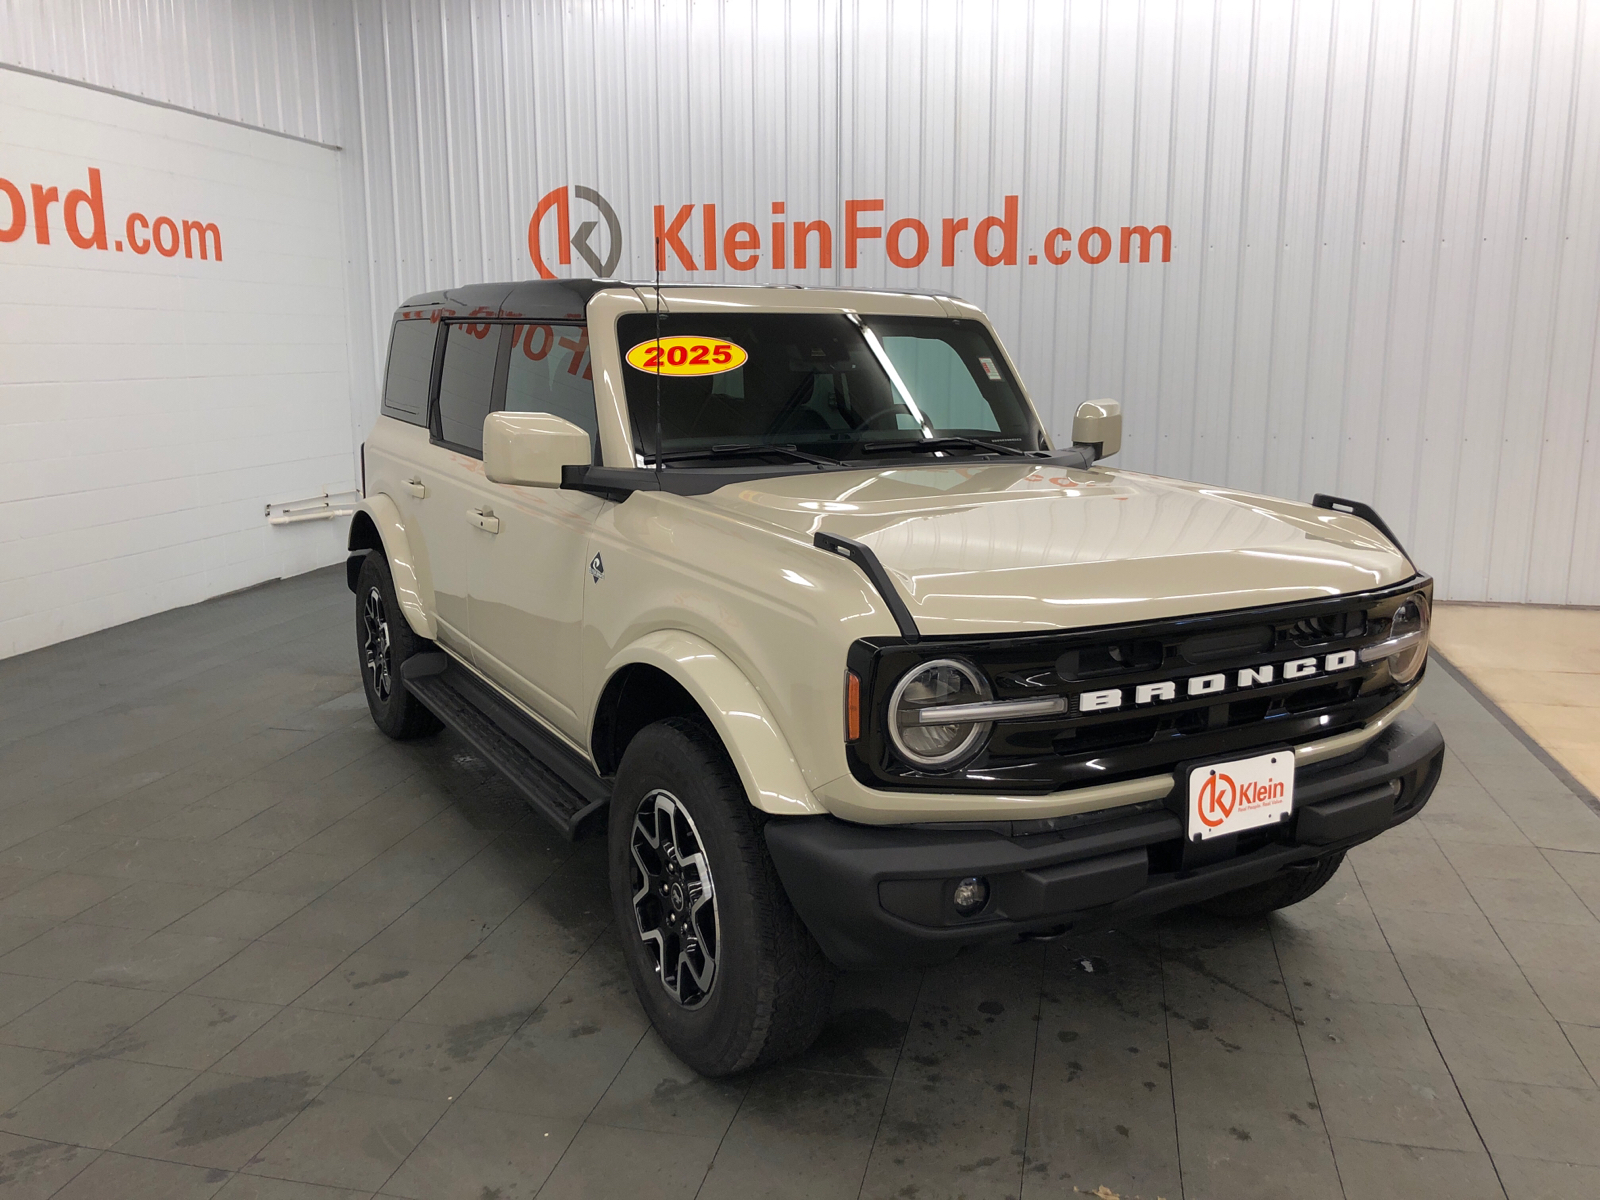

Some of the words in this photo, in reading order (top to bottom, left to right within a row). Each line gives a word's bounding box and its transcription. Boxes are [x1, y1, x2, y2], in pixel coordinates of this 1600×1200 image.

[653, 194, 1172, 272] KleinFord.com
[643, 345, 732, 368] 2025
[1079, 650, 1356, 712] BRONCO
[1238, 777, 1285, 806] Klein
